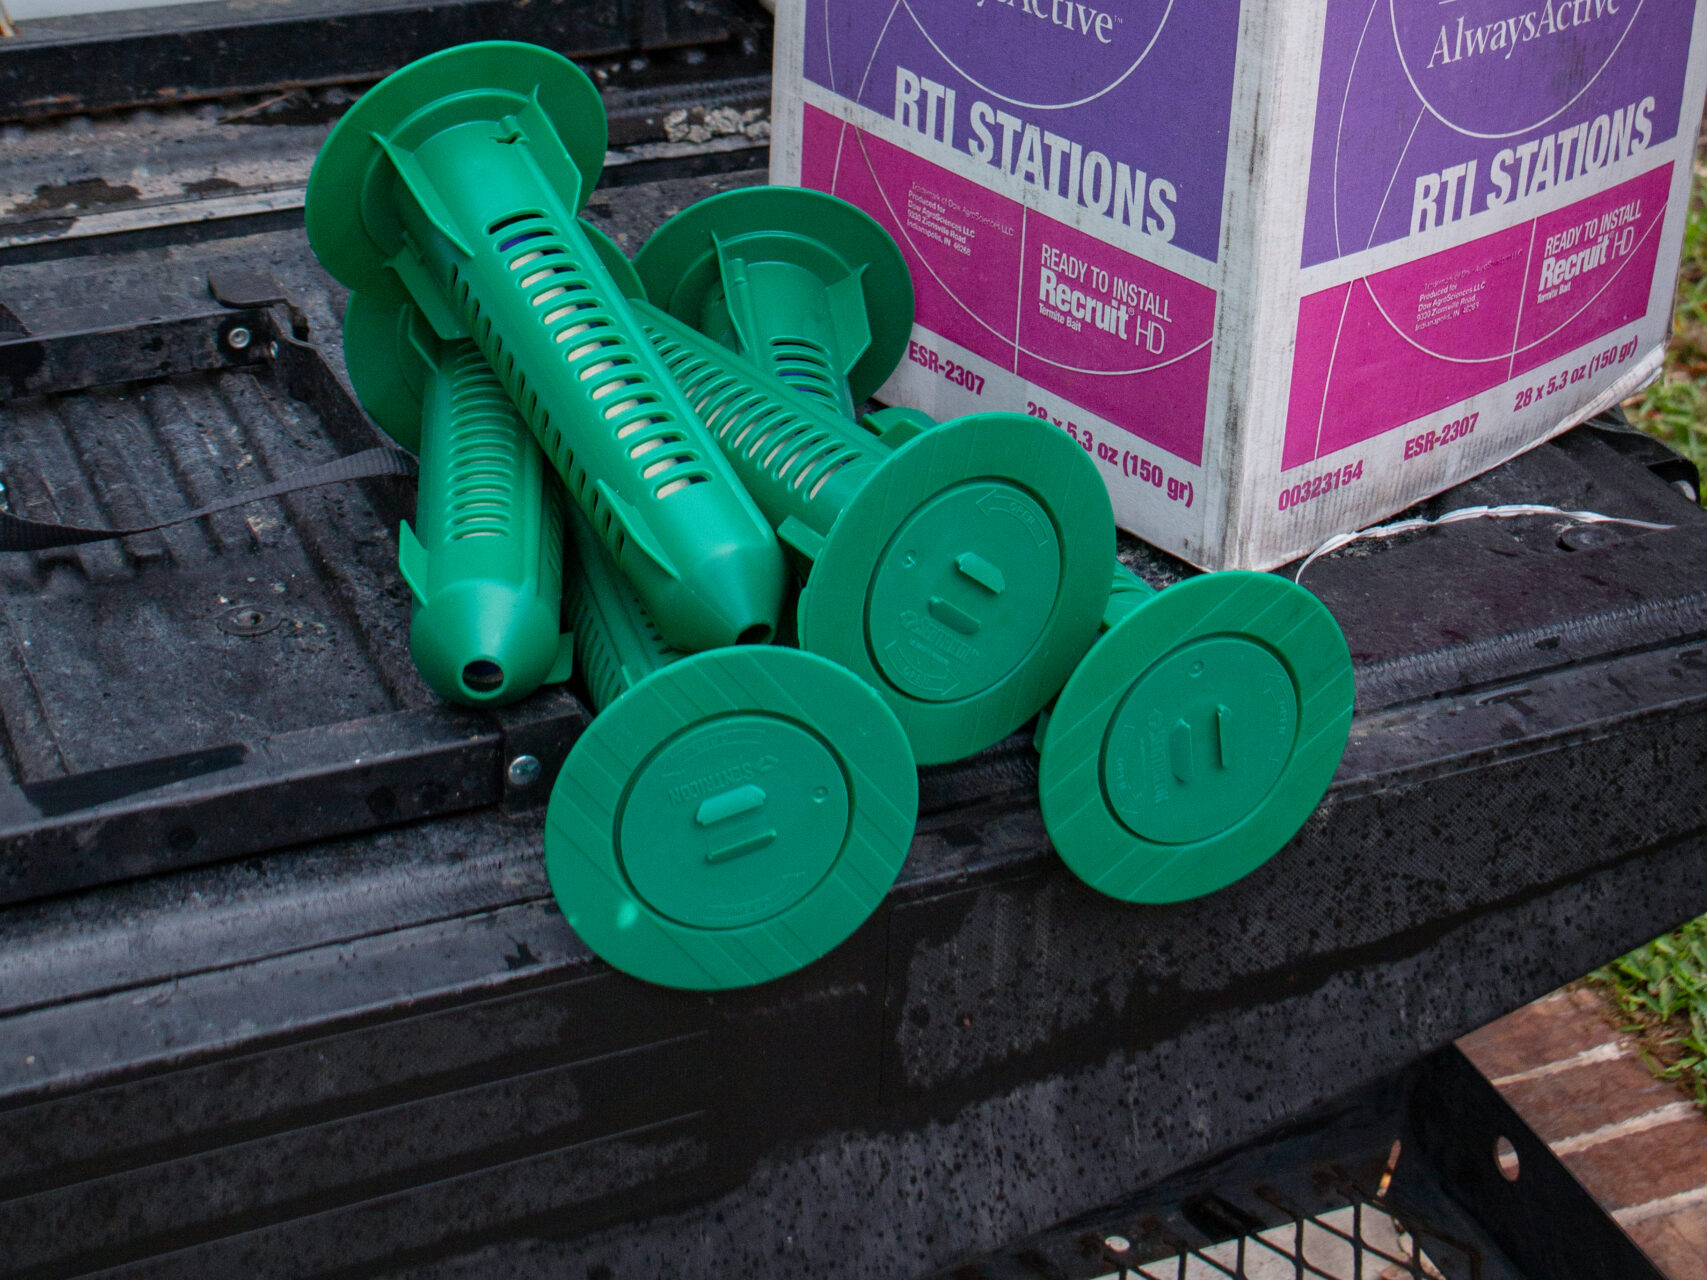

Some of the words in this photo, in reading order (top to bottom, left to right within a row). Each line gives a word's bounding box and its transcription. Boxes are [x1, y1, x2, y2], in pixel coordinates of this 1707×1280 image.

[895, 65, 956, 147] RTI
[968, 101, 1177, 244] STATIONS
[1409, 159, 1478, 236] RTI
[1486, 96, 1655, 210] STATIONS
[908, 190, 937, 210] Produced
[922, 207, 962, 232] AgroSciences
[963, 226, 976, 238] LLC
[950, 230, 967, 244] Road
[1544, 224, 1583, 259] READY
[1584, 218, 1598, 242] TO
[1599, 199, 1642, 234] INSTALL
[1611, 226, 1635, 260] HD
[1041, 243, 1088, 283] READY
[1091, 265, 1109, 293] TO
[1112, 276, 1172, 323] INSTALL
[1473, 281, 1486, 292] LLC
[1039, 302, 1065, 325] Termite
[1066, 316, 1082, 332] Bait
[1135, 315, 1165, 354] HD
[908, 339, 985, 397] ESR-2307
[1513, 390, 1533, 412] 28
[1534, 385, 1544, 403] x
[1546, 372, 1567, 397] 5.3
[1570, 366, 1586, 384] oz
[1587, 351, 1616, 381] (150
[1617, 335, 1639, 368] gr)
[1403, 412, 1479, 461] ESR-2307
[1067, 421, 1093, 452] 5.3
[1097, 442, 1119, 466] oz
[1122, 450, 1164, 488] (150
[1167, 477, 1194, 508] gr)
[1277, 459, 1364, 512] 00323154
